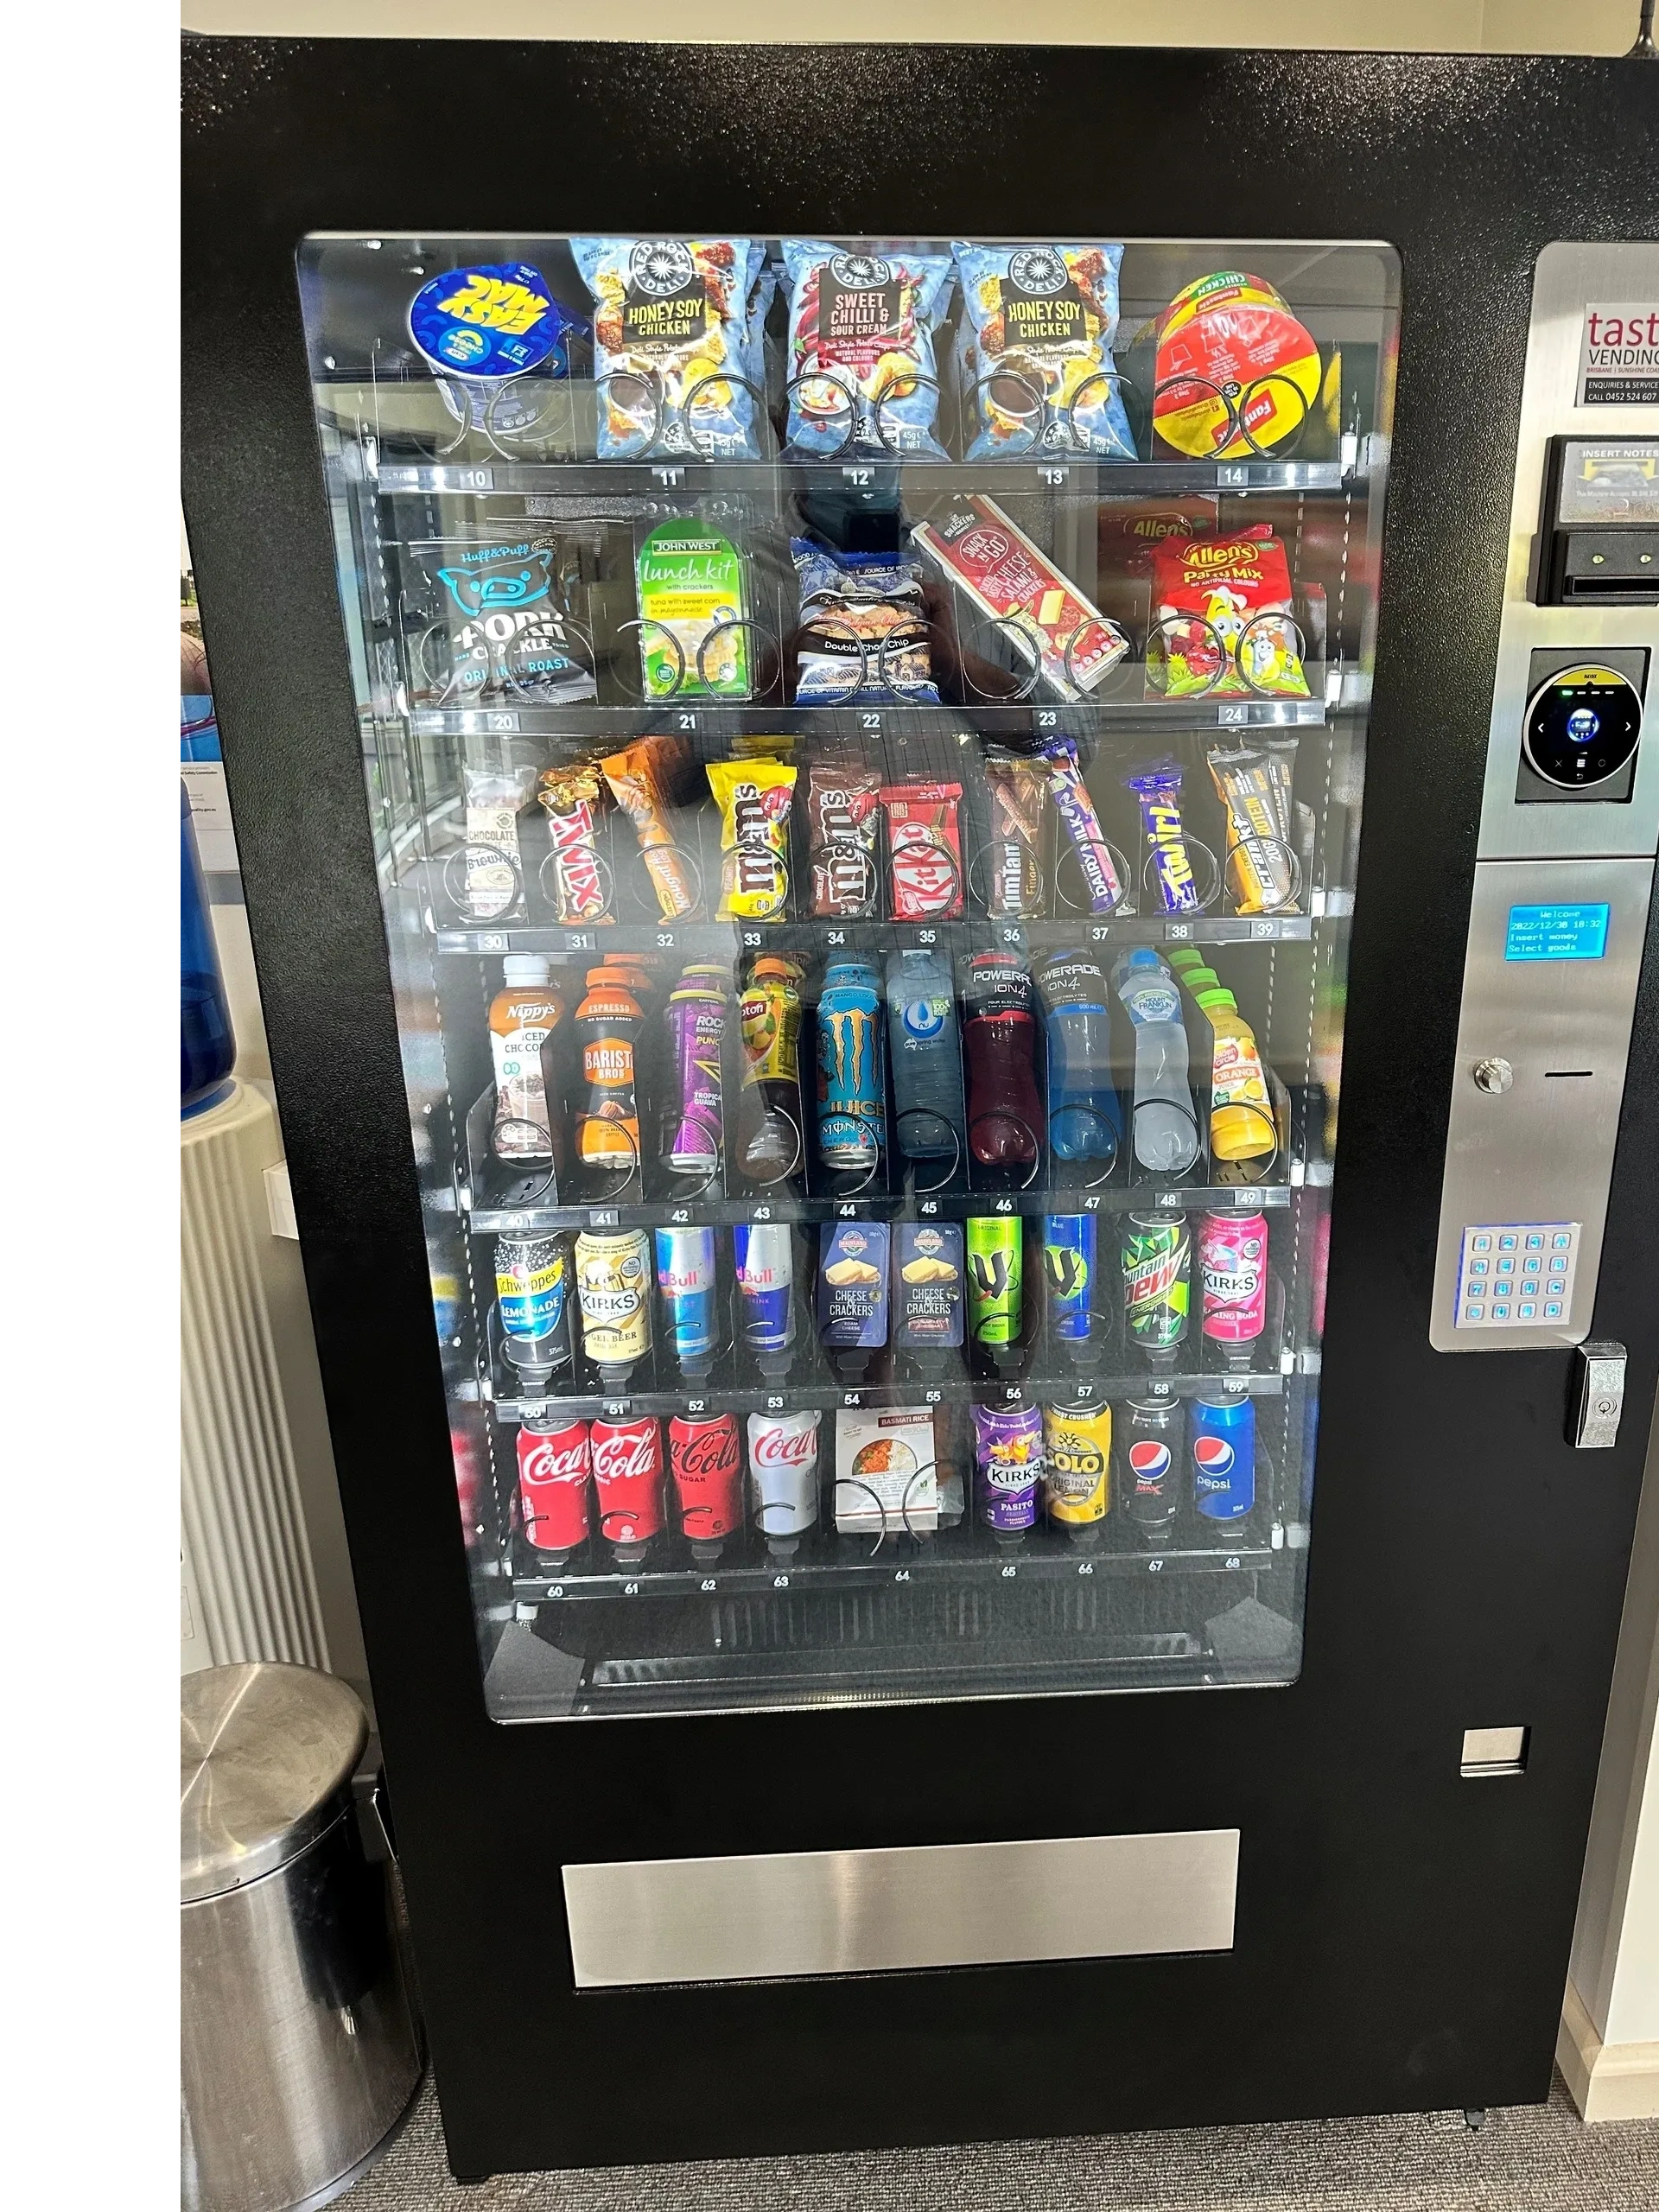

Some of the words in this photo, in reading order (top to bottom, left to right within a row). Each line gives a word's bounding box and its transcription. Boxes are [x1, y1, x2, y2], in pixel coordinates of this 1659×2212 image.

[647, 279, 683, 293] DELI
[1023, 277, 1060, 293] DELI
[1198, 273, 1246, 297] CHICKEN
[454, 274, 550, 314] MAC
[835, 293, 887, 309] SWEET
[437, 296, 546, 335] EASY
[629, 301, 675, 326] HONEY
[677, 298, 703, 319] SOY
[830, 309, 876, 325] CHILLI
[880, 308, 890, 323] &
[1007, 301, 1052, 323] HONEY
[1055, 301, 1081, 321] SOY
[639, 320, 691, 336] CHICKEN
[830, 326, 855, 336] SOUR
[856, 324, 888, 336] CREAM
[1020, 322, 1071, 338] CHICKEN
[1588, 381, 1624, 390] ENQUIRIES
[1632, 381, 1659, 390] SERVICE
[1605, 392, 1624, 401] 0452
[1626, 392, 1641, 401] 524
[1642, 392, 1657, 401] 607
[721, 448, 736, 456] NET
[1096, 446, 1110, 454] NET
[1582, 449, 1621, 458] INSERT
[1624, 449, 1659, 458] NOTES
[467, 471, 486, 486] 10
[660, 470, 677, 486] 11
[851, 470, 869, 486] 12
[1045, 469, 1063, 485] 13
[1224, 471, 1243, 483] 14
[944, 513, 976, 537] SNACKERS
[1134, 520, 1189, 537] Allen's
[655, 542, 687, 552] JOHN
[689, 542, 718, 551] WEST
[962, 534, 989, 558] SNACK
[988, 537, 1006, 559] GO
[461, 543, 530, 563] Huff&Puff
[1189, 544, 1254, 566] Allen's
[644, 560, 704, 582] lunch
[705, 558, 734, 582] kit
[995, 551, 1031, 587] CHEESE
[1232, 567, 1264, 580] Mix
[1001, 573, 1032, 601] SALAMI
[660, 607, 703, 617] mayonnaise
[453, 610, 567, 650] PORK
[824, 641, 858, 653] Double
[887, 639, 909, 650] Chip
[528, 658, 569, 673] ROAST
[862, 715, 880, 728] 22
[1039, 712, 1057, 726] 23
[1225, 709, 1243, 721] 24
[493, 715, 513, 730] 20
[679, 715, 696, 729] 21
[468, 830, 515, 842] CHOCOLATE
[549, 799, 603, 912] TWIX
[1147, 806, 1193, 898] Twirl
[467, 850, 522, 870] Brownie
[1172, 925, 1188, 938] 38
[1257, 923, 1274, 937] 39
[1510, 921, 1568, 931] 2022/12/30
[744, 933, 762, 946] 33
[828, 932, 845, 944] 34
[919, 931, 936, 944] 35
[1003, 929, 1020, 942] 36
[1092, 927, 1109, 940] 37
[1510, 933, 1544, 942] Insert
[485, 935, 503, 950] 30
[571, 935, 588, 949] 31
[657, 934, 675, 947] 32
[1509, 944, 1543, 953] Select
[1548, 943, 1577, 952] goods
[505, 1001, 556, 1022] Nippy's
[588, 1004, 631, 1014] ESPRESSO
[1139, 1001, 1173, 1010] FRANKLIN
[696, 1027, 722, 1035] ENERGY
[598, 1070, 626, 1080] BROS
[1216, 1067, 1257, 1082] ORANGE
[694, 1098, 717, 1107] GUAVA
[1084, 1197, 1101, 1209] 47
[1160, 1194, 1177, 1206] 48
[1240, 1192, 1255, 1204] 49
[839, 1204, 856, 1217] 44
[921, 1202, 937, 1214] 45
[995, 1199, 1013, 1211] 46
[596, 1211, 612, 1224] 41
[671, 1211, 689, 1223] 42
[753, 1206, 771, 1219] 43
[505, 1214, 523, 1227] 40
[498, 1269, 556, 1294] Schweppes
[670, 1271, 698, 1287] Bull
[746, 1268, 772, 1283] Bull
[1203, 1273, 1254, 1291] KIRKS
[835, 1290, 868, 1301] CHEESE
[912, 1287, 945, 1300] CHEESE
[501, 1296, 560, 1318] LEMONADE
[582, 1294, 635, 1310] KIRKS
[906, 1302, 951, 1315] CRACKERS
[830, 1304, 874, 1318] CRACKERS
[612, 1331, 638, 1343] BEER
[1006, 1388, 1022, 1400] 56
[1077, 1385, 1093, 1397] 57
[1154, 1383, 1169, 1395] 58
[1228, 1382, 1244, 1393] 59
[768, 1397, 784, 1408] 53
[844, 1394, 861, 1405] 54
[925, 1390, 942, 1402] 55
[609, 1403, 625, 1414] 51
[689, 1400, 704, 1412] 52
[524, 1408, 541, 1419] 50
[881, 1415, 912, 1426] BASMATI
[912, 1414, 930, 1423] RICE
[593, 1427, 655, 1478] Cola
[679, 1474, 707, 1484] SUGAR
[992, 1462, 1040, 1483] KIRKS
[1197, 1476, 1232, 1491] pepsi
[1001, 1499, 1033, 1511] PASITO
[1078, 1563, 1094, 1575] 66
[1148, 1560, 1164, 1572] 67
[1225, 1557, 1241, 1569] 68
[895, 1570, 910, 1582] 64
[1001, 1566, 1016, 1577] 65
[625, 1582, 639, 1594] 61
[701, 1580, 716, 1591] 62
[773, 1576, 789, 1587] 63
[547, 1586, 563, 1598] 60
